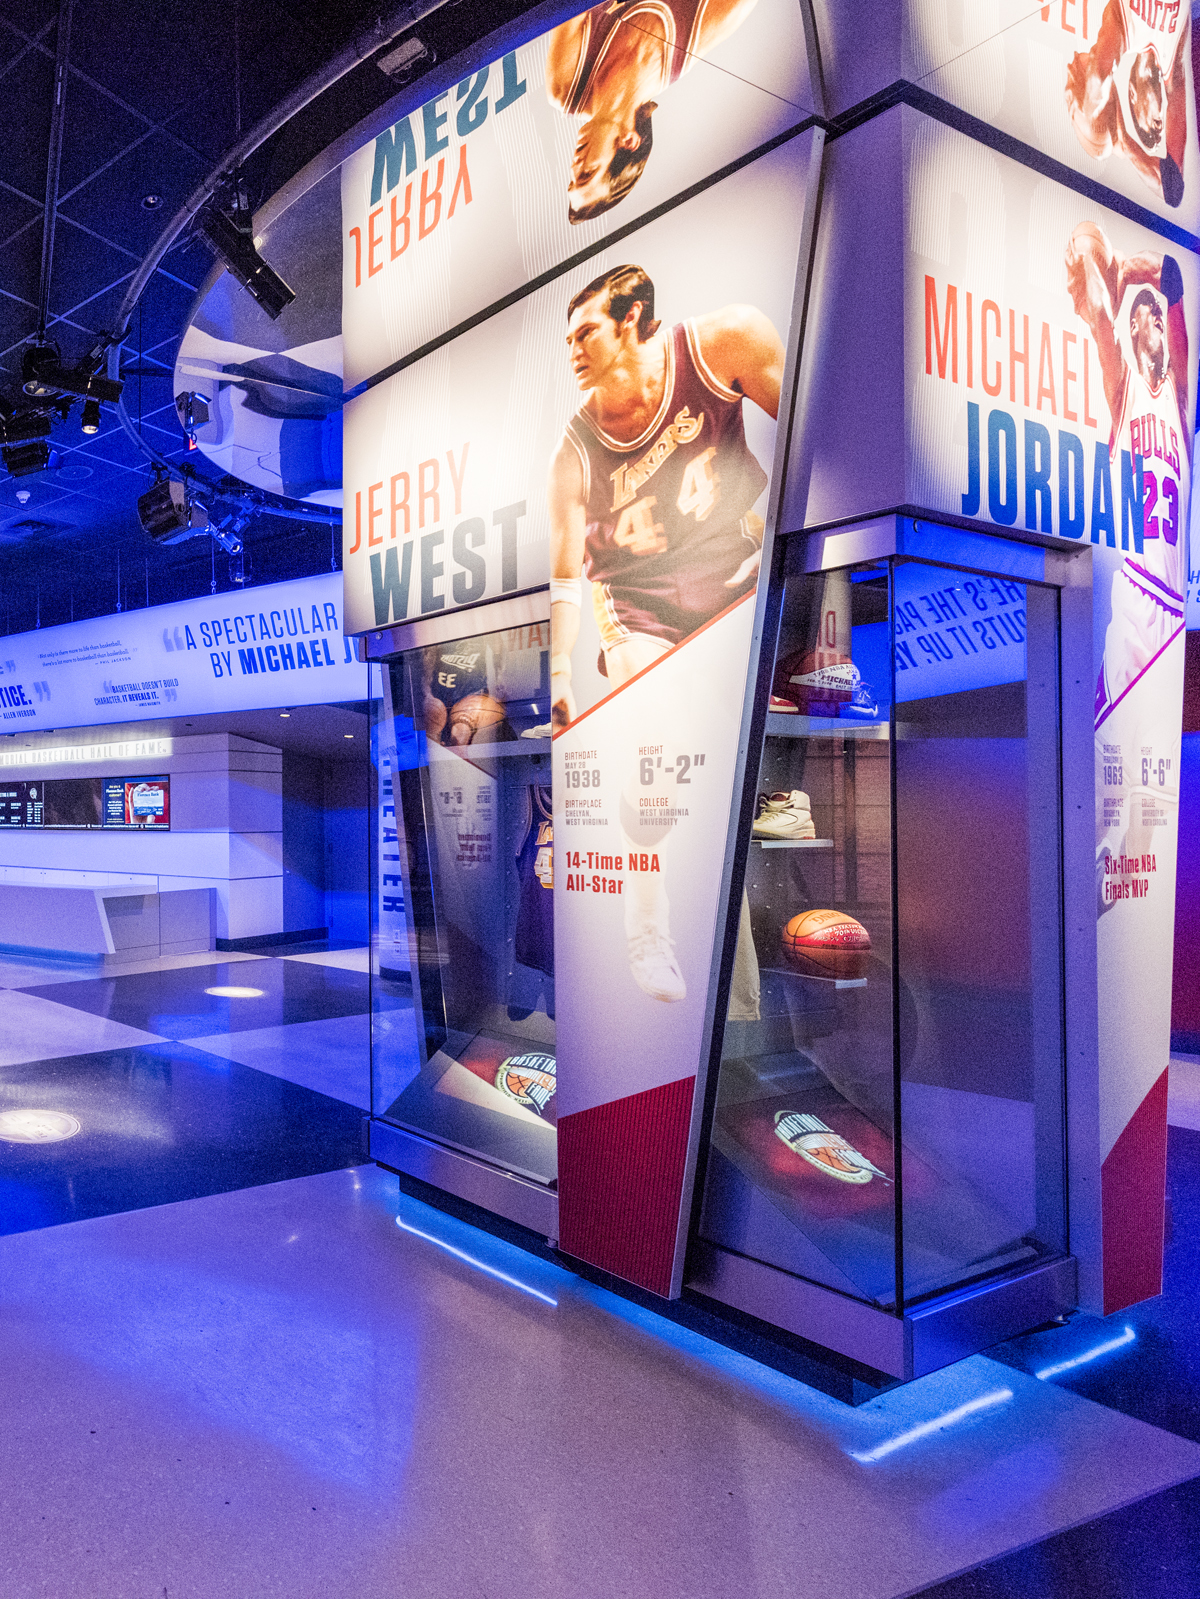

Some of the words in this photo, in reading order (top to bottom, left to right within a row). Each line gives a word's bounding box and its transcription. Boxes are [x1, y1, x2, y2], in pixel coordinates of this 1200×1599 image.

[924, 274, 1098, 429] MICHAEL
[1130, 413, 1181, 481] BULLS
[962, 400, 1144, 555] JORDAN
[349, 442, 471, 555] JERRY
[1143, 470, 1179, 547] 23
[370, 499, 527, 626] WEST
[185, 625, 197, 650] A
[199, 602, 338, 648] SPECTACULAR
[210, 651, 232, 678] BY
[238, 638, 335, 675] MICHAEL
[3, 711, 16, 719] ALLEN
[17, 709, 36, 718] IVERSON
[32, 748, 85, 763] BASKETBALL
[91, 745, 113, 759] HALL
[118, 743, 130, 756] OF
[136, 741, 162, 755] FAME
[565, 750, 597, 760] BIRTHDATE
[639, 745, 664, 755] HEIGHT
[565, 769, 600, 789] 1938
[639, 754, 706, 785] 6'-2"
[1103, 766, 1123, 785] 1963
[1142, 758, 1171, 786] 6'-6"
[565, 799, 602, 808] BIRTHPLACE
[639, 797, 669, 807] COLLEGE
[659, 808, 689, 816] VIRGINIA
[565, 810, 592, 818] CHELYAN,
[565, 818, 581, 826] WEST
[582, 818, 608, 826] VIRGINIA
[640, 818, 678, 826] UNIVERSITY
[566, 851, 623, 871] 14-Time
[628, 853, 660, 872] NBA
[1105, 855, 1139, 875] Six-Time
[1141, 854, 1157, 872] NBA
[566, 874, 623, 894] All-Star
[1105, 880, 1129, 900] Finals
[1132, 879, 1149, 898] MVP
[527, 1084, 554, 1110] FAME
